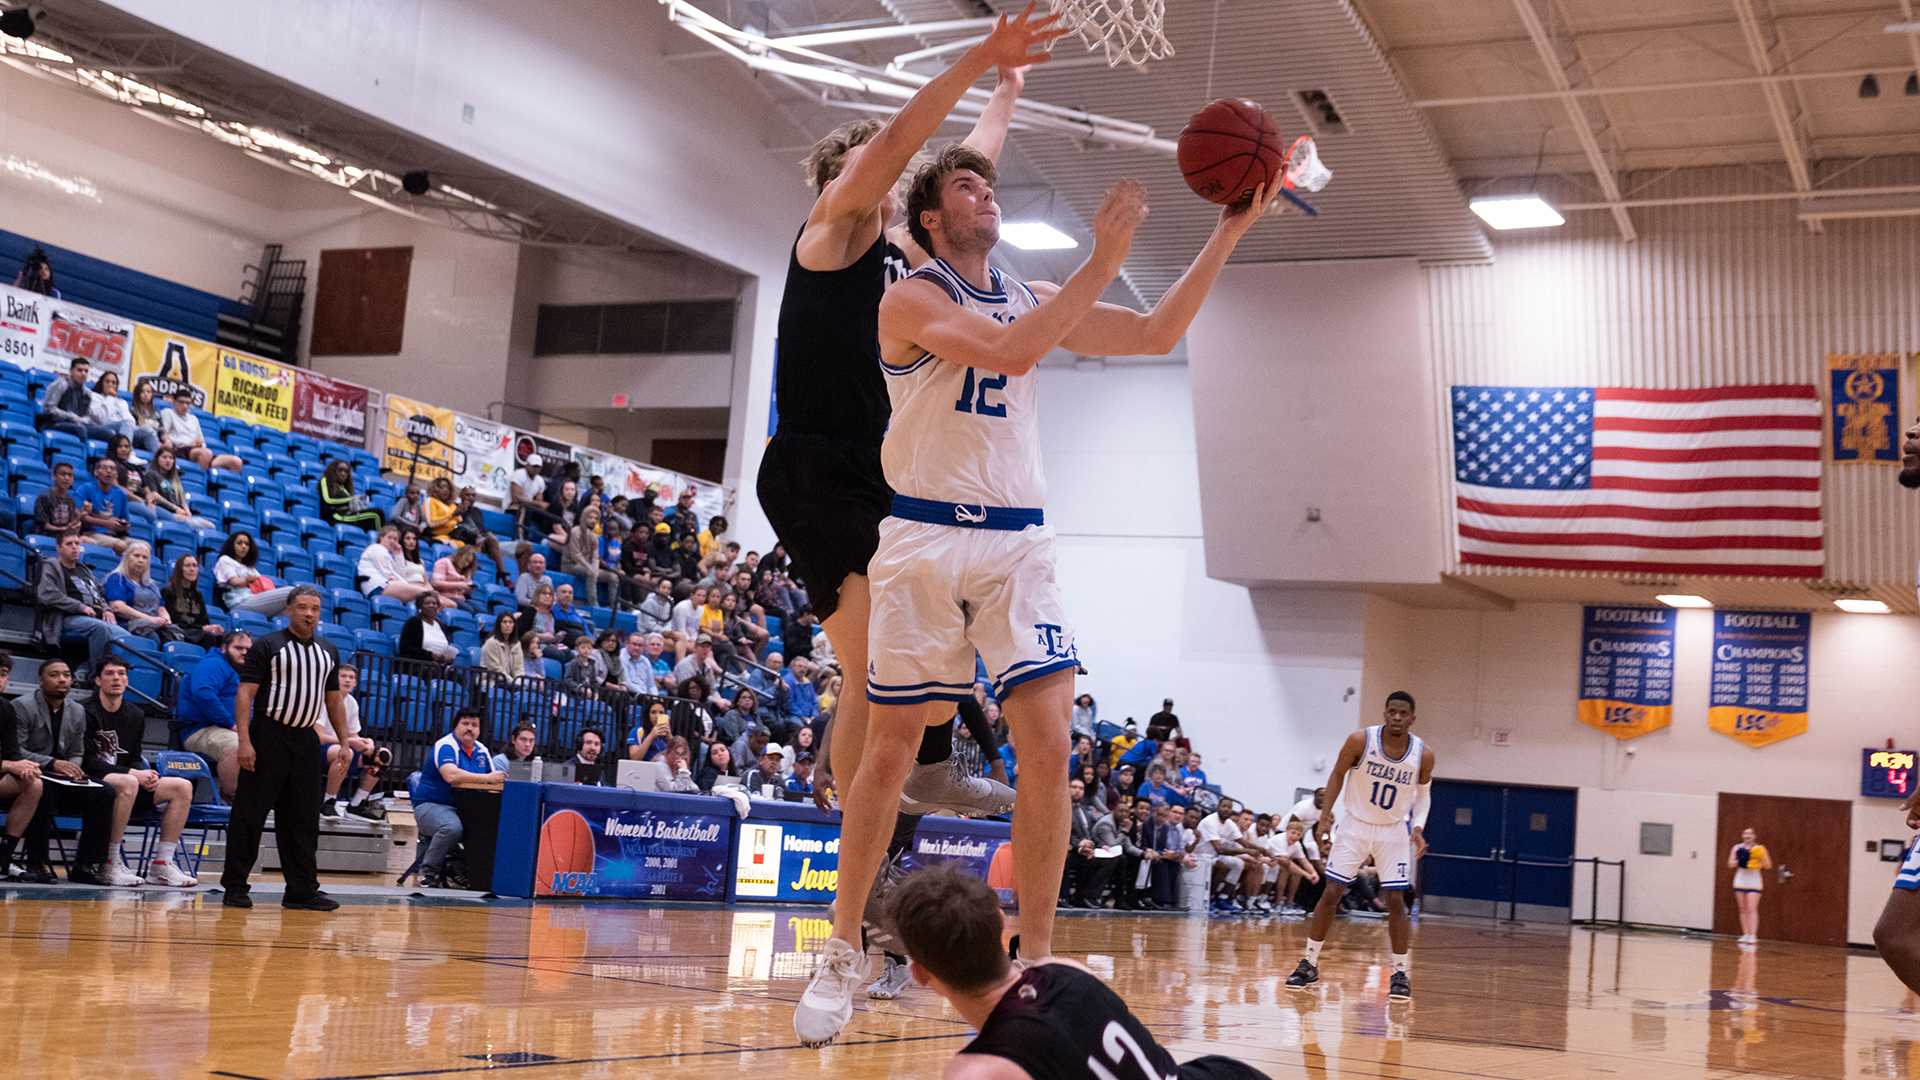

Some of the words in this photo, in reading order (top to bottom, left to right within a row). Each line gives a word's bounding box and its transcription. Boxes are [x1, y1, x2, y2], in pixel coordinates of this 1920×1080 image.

[7, 295, 39, 324] Bank
[232, 377, 278, 402] RICARDO
[955, 366, 1008, 418] 12
[217, 389, 253, 412] RANCH
[255, 402, 262, 415] &
[265, 403, 288, 421] FEED
[1594, 608, 1667, 624] FOOTBALL
[1724, 613, 1799, 629] FOOTBALL
[167, 760, 202, 771] JAVELINAS
[1366, 761, 1396, 781] TEXAS
[1395, 769, 1413, 786] A&I
[1887, 769, 1908, 794] 4
[1369, 780, 1398, 811] 10
[604, 817, 654, 838] Women's
[655, 820, 721, 843] Basketball
[647, 845, 698, 858] TOURNAMENT
[783, 834, 823, 853] Home
[824, 838, 840, 854] of
[918, 838, 941, 854] Men's
[941, 839, 987, 857] Basketball
[663, 858, 678, 869] 2001
[551, 872, 597, 894] NCAA
[650, 884, 667, 896] 2001
